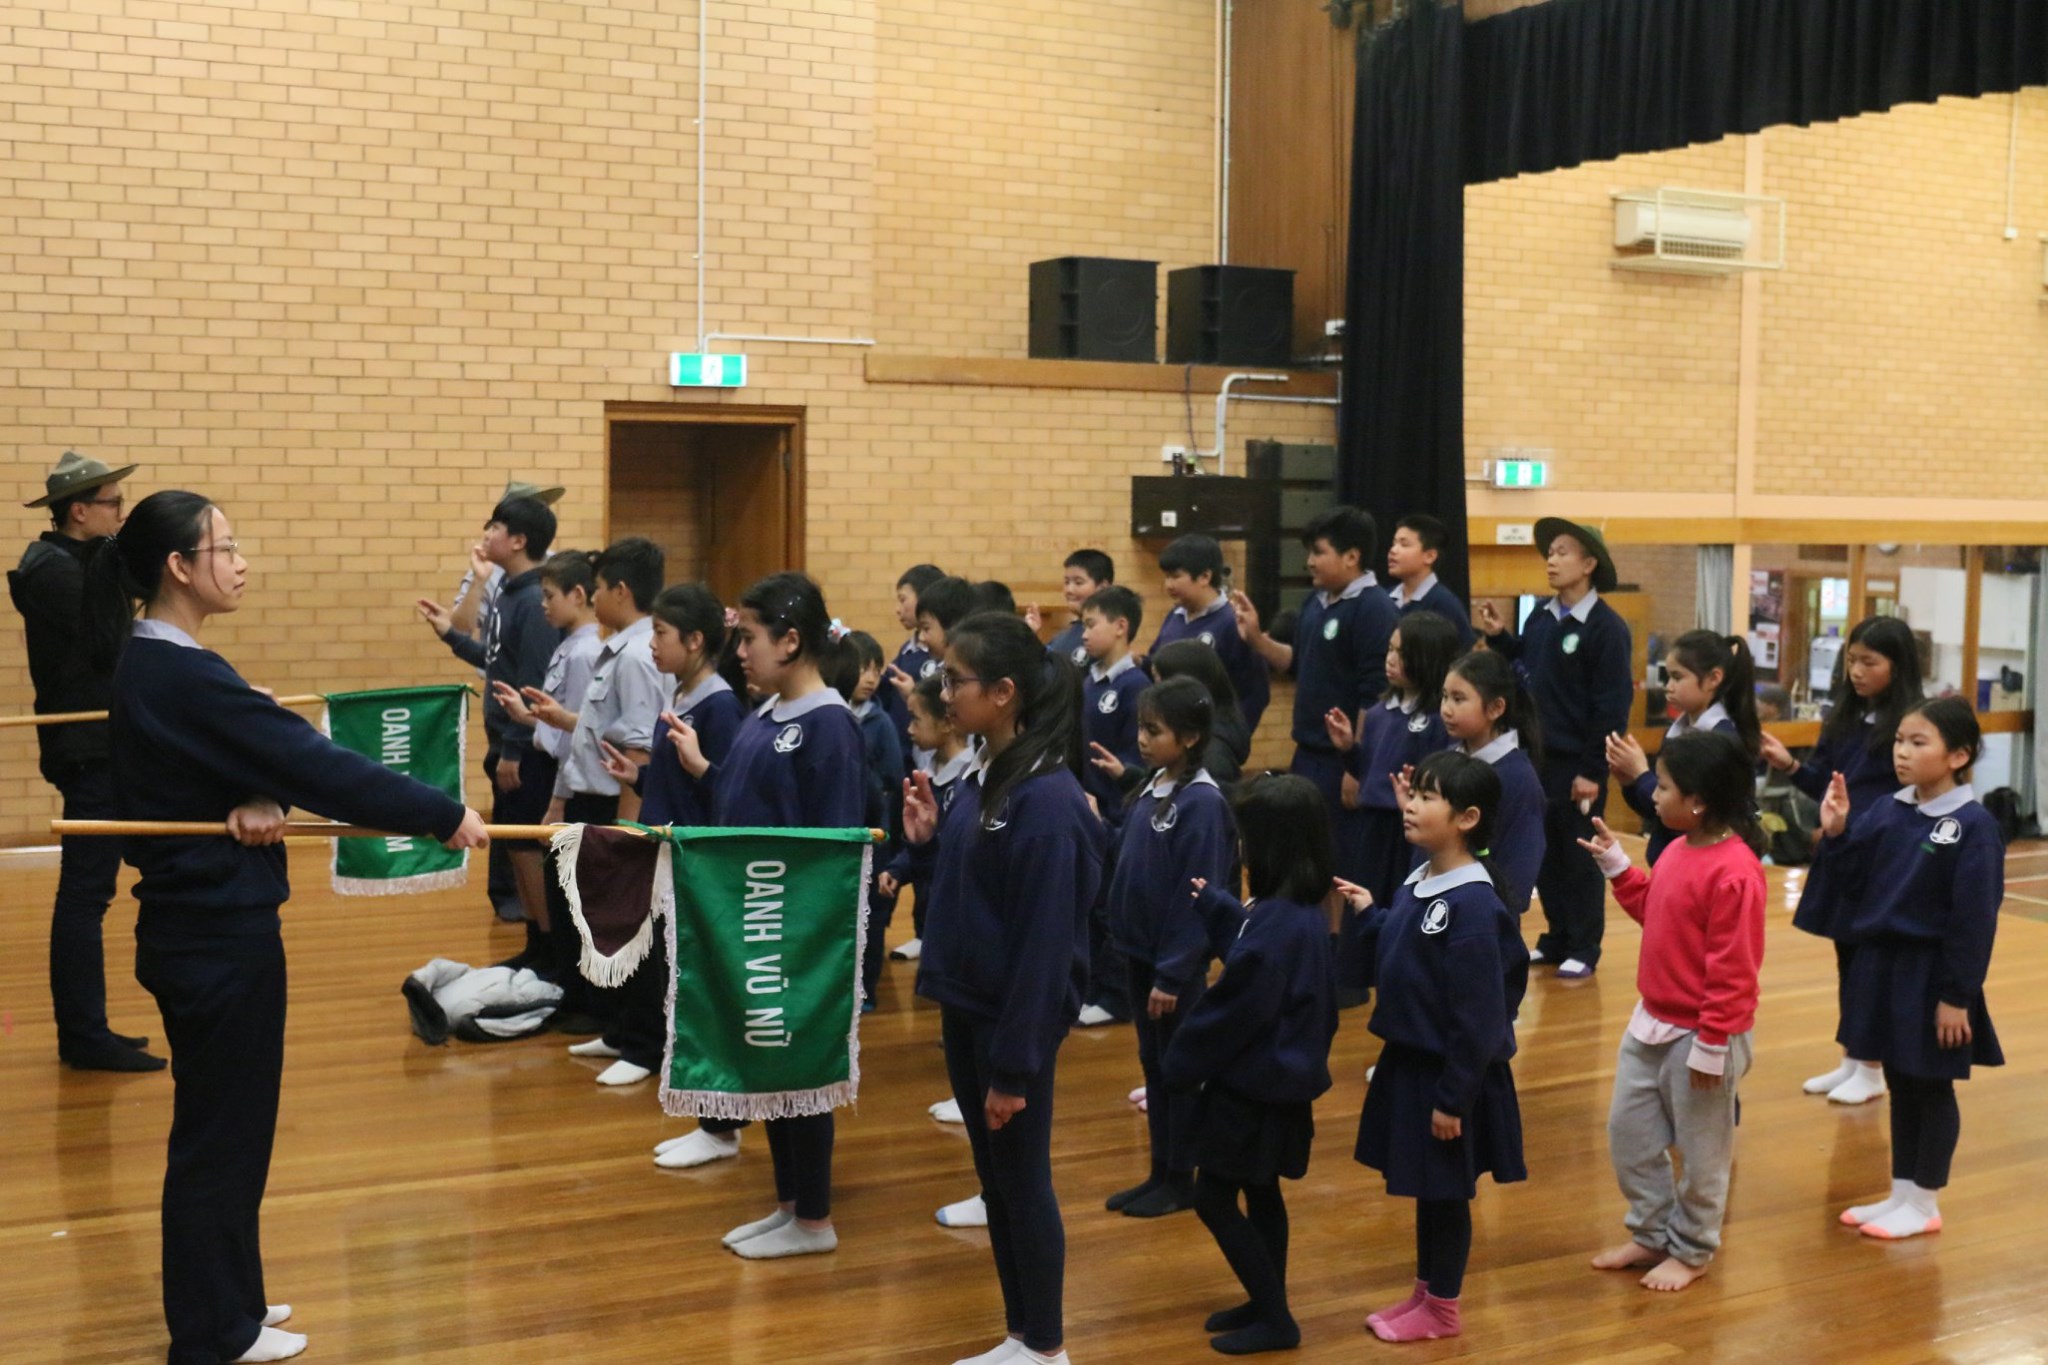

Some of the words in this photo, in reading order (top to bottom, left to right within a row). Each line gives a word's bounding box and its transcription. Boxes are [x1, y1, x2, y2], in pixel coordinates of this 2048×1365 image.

[381, 707, 411, 765] OANH
[743, 860, 787, 942] OANH
[745, 953, 789, 995] VŨ
